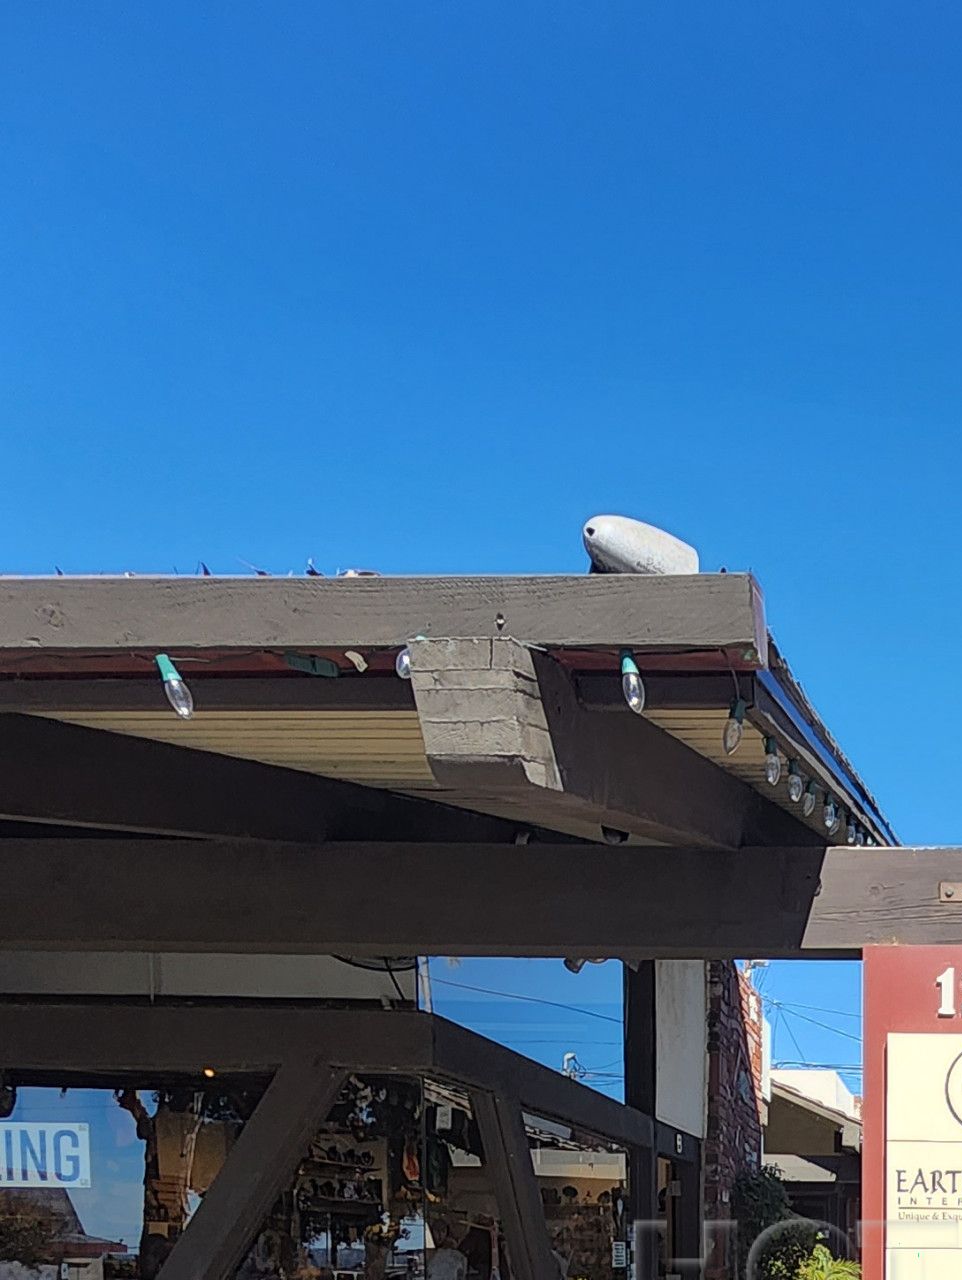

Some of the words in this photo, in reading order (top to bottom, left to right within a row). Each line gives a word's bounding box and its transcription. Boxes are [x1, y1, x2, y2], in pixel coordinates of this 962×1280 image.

[0, 1130, 80, 1182] ING
[898, 1211, 930, 1223] Unique
[932, 1212, 940, 1222] &
